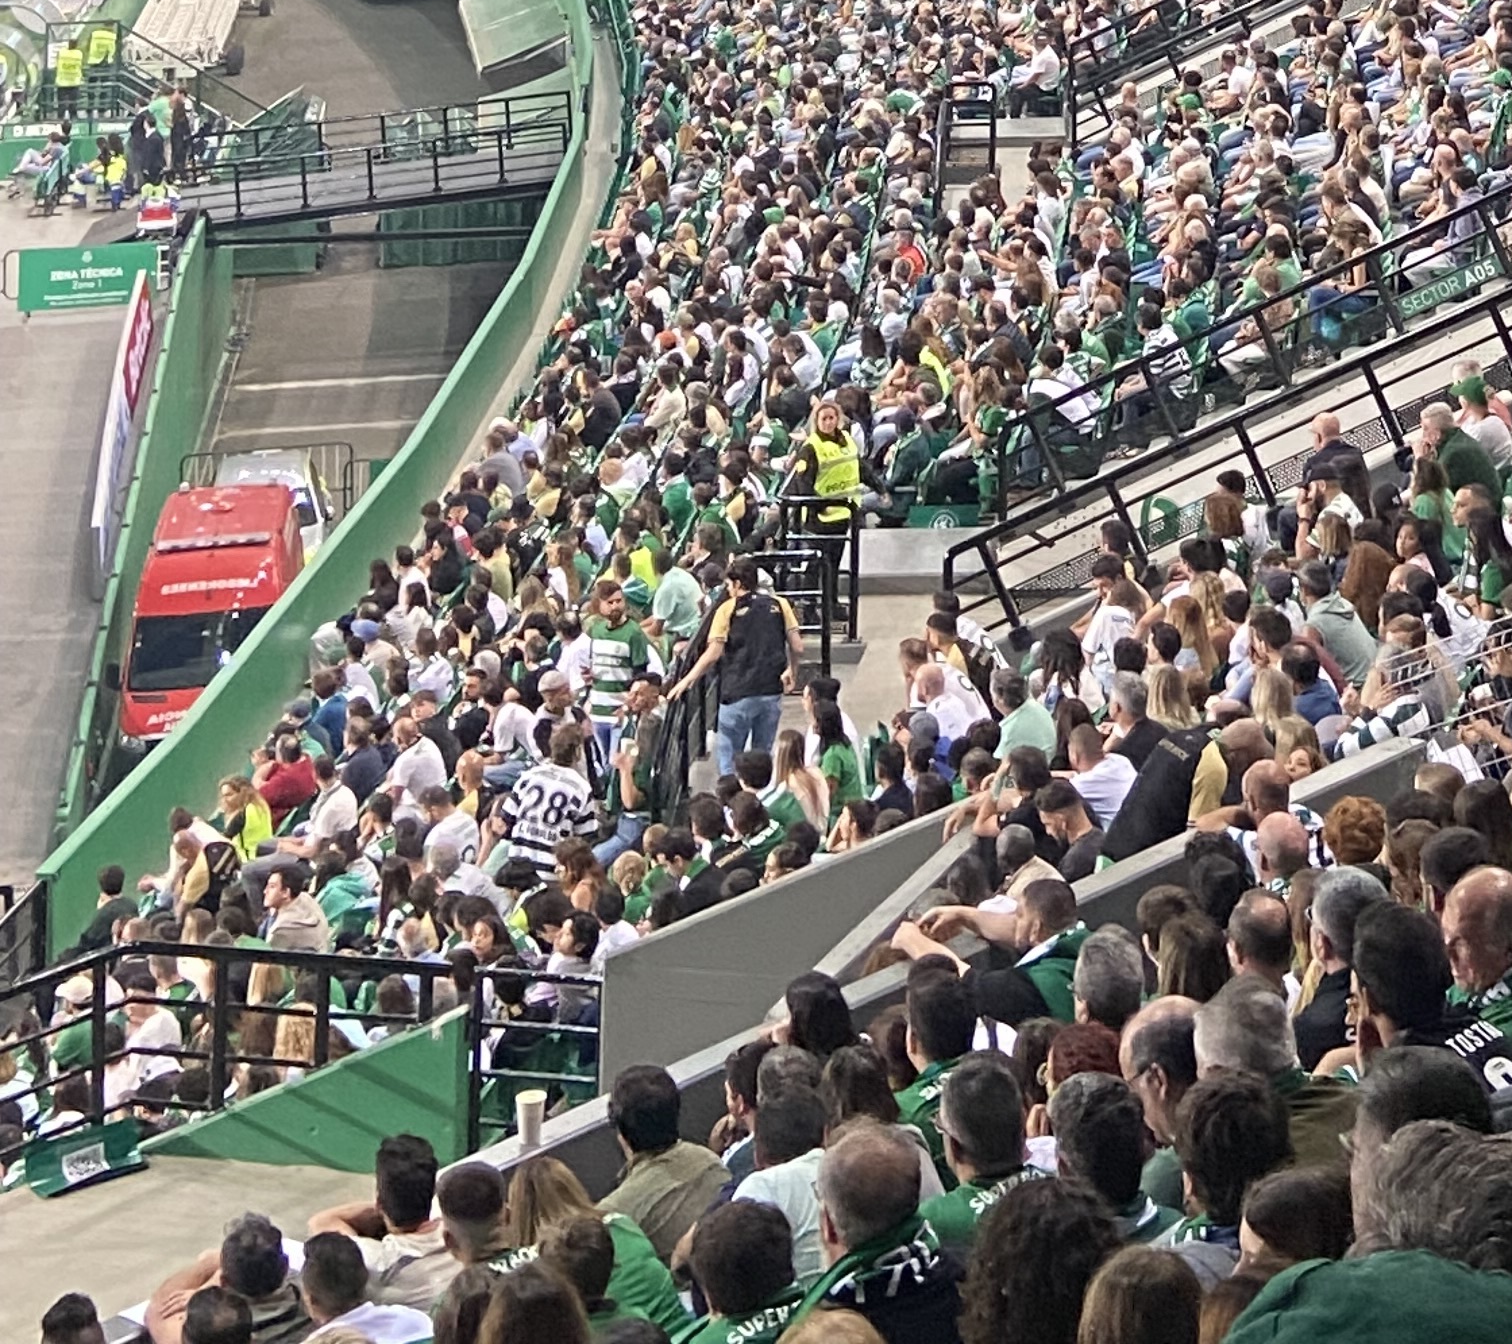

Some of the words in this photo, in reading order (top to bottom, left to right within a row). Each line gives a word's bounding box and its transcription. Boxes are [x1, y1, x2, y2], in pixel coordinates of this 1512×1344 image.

[1401, 276, 1462, 315] SECTOR
[1463, 259, 1496, 287] A05
[519, 784, 568, 826] 28
